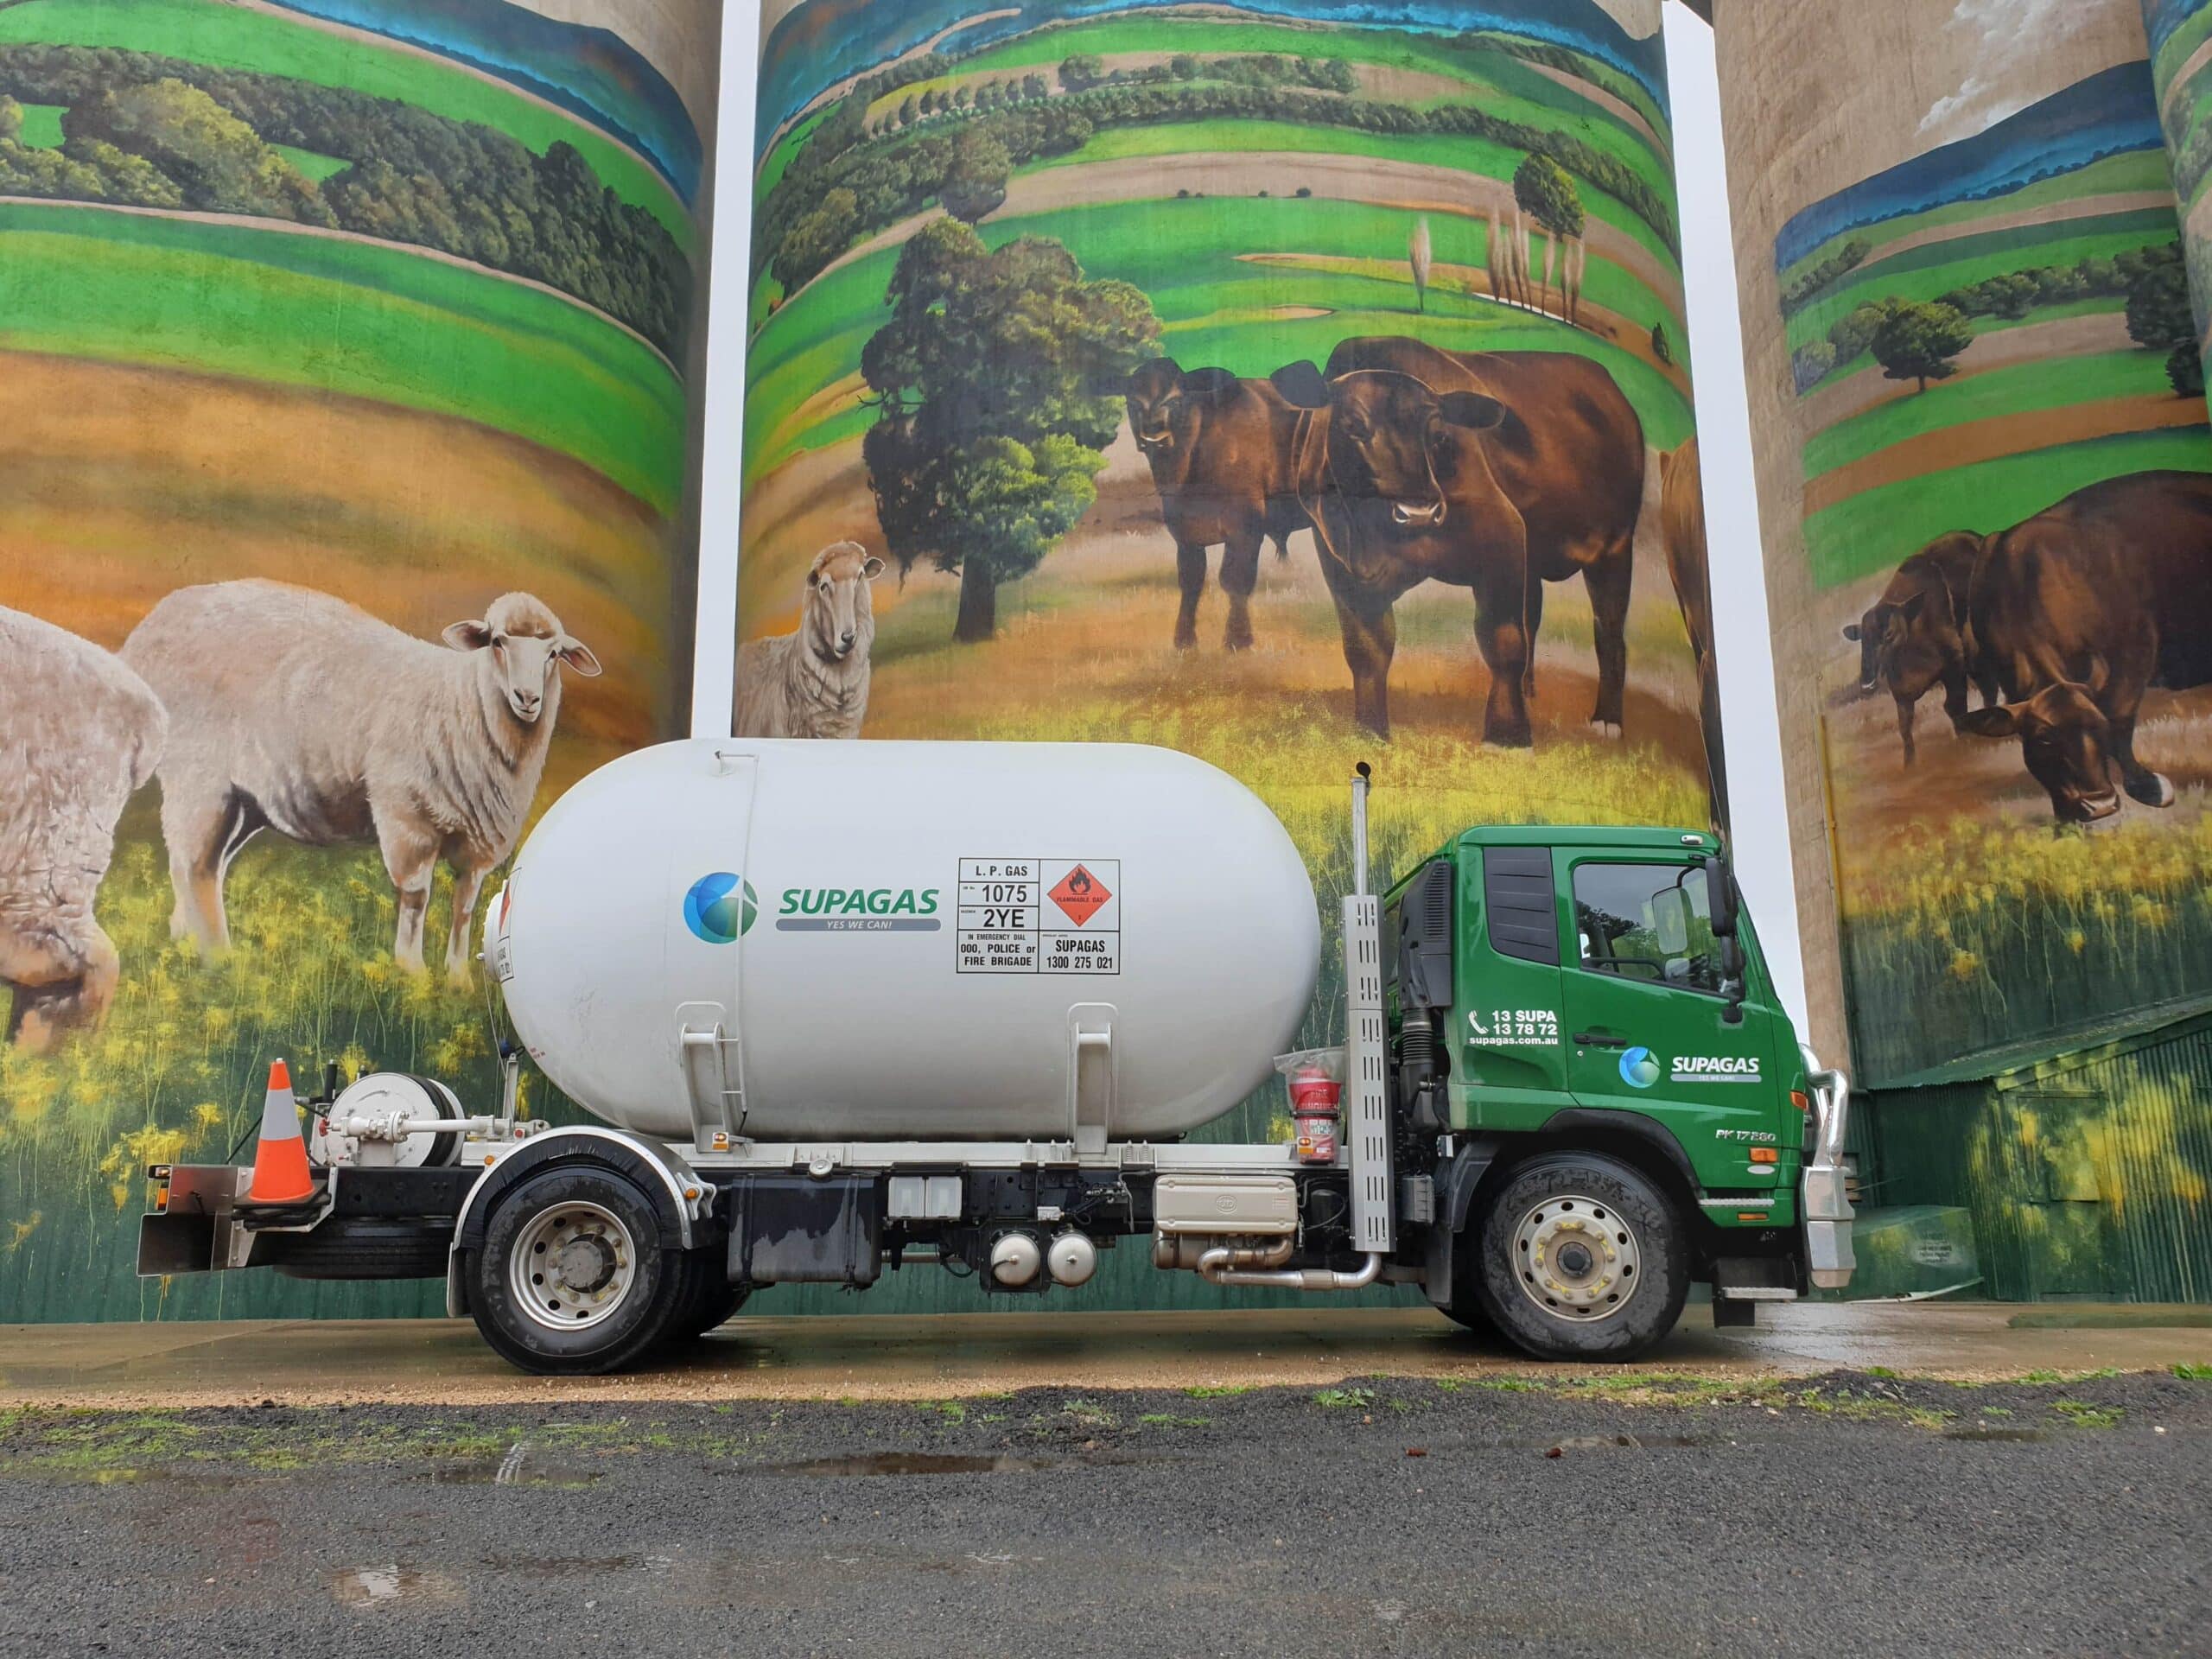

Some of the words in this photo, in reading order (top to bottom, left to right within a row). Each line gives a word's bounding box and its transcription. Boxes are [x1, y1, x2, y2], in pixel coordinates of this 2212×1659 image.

[1005, 866, 1028, 877] GAS
[982, 884, 1027, 903] 1075
[779, 888, 939, 914] SUPAGAS
[827, 920, 844, 929] YES
[848, 920, 864, 929] WE
[867, 920, 893, 929] CAN!
[983, 908, 1025, 928] 2YE
[988, 944, 1020, 954] POLICE
[1055, 940, 1105, 952] SUPAGAS
[964, 956, 985, 966] FIRE
[991, 957, 1032, 967] BRIGADE
[1046, 956, 1069, 969] 1300
[1074, 957, 1091, 969] 275
[1096, 957, 1113, 969] 021
[1491, 1010, 1511, 1022] 13
[1515, 1009, 1557, 1022] SUPA
[1493, 1023, 1511, 1035] 13
[1516, 1023, 1535, 1035] 78
[1538, 1024, 1558, 1036] 72
[1469, 1037, 1559, 1046] supagas.com.au
[1671, 1057, 1759, 1073] SUPAGAS
